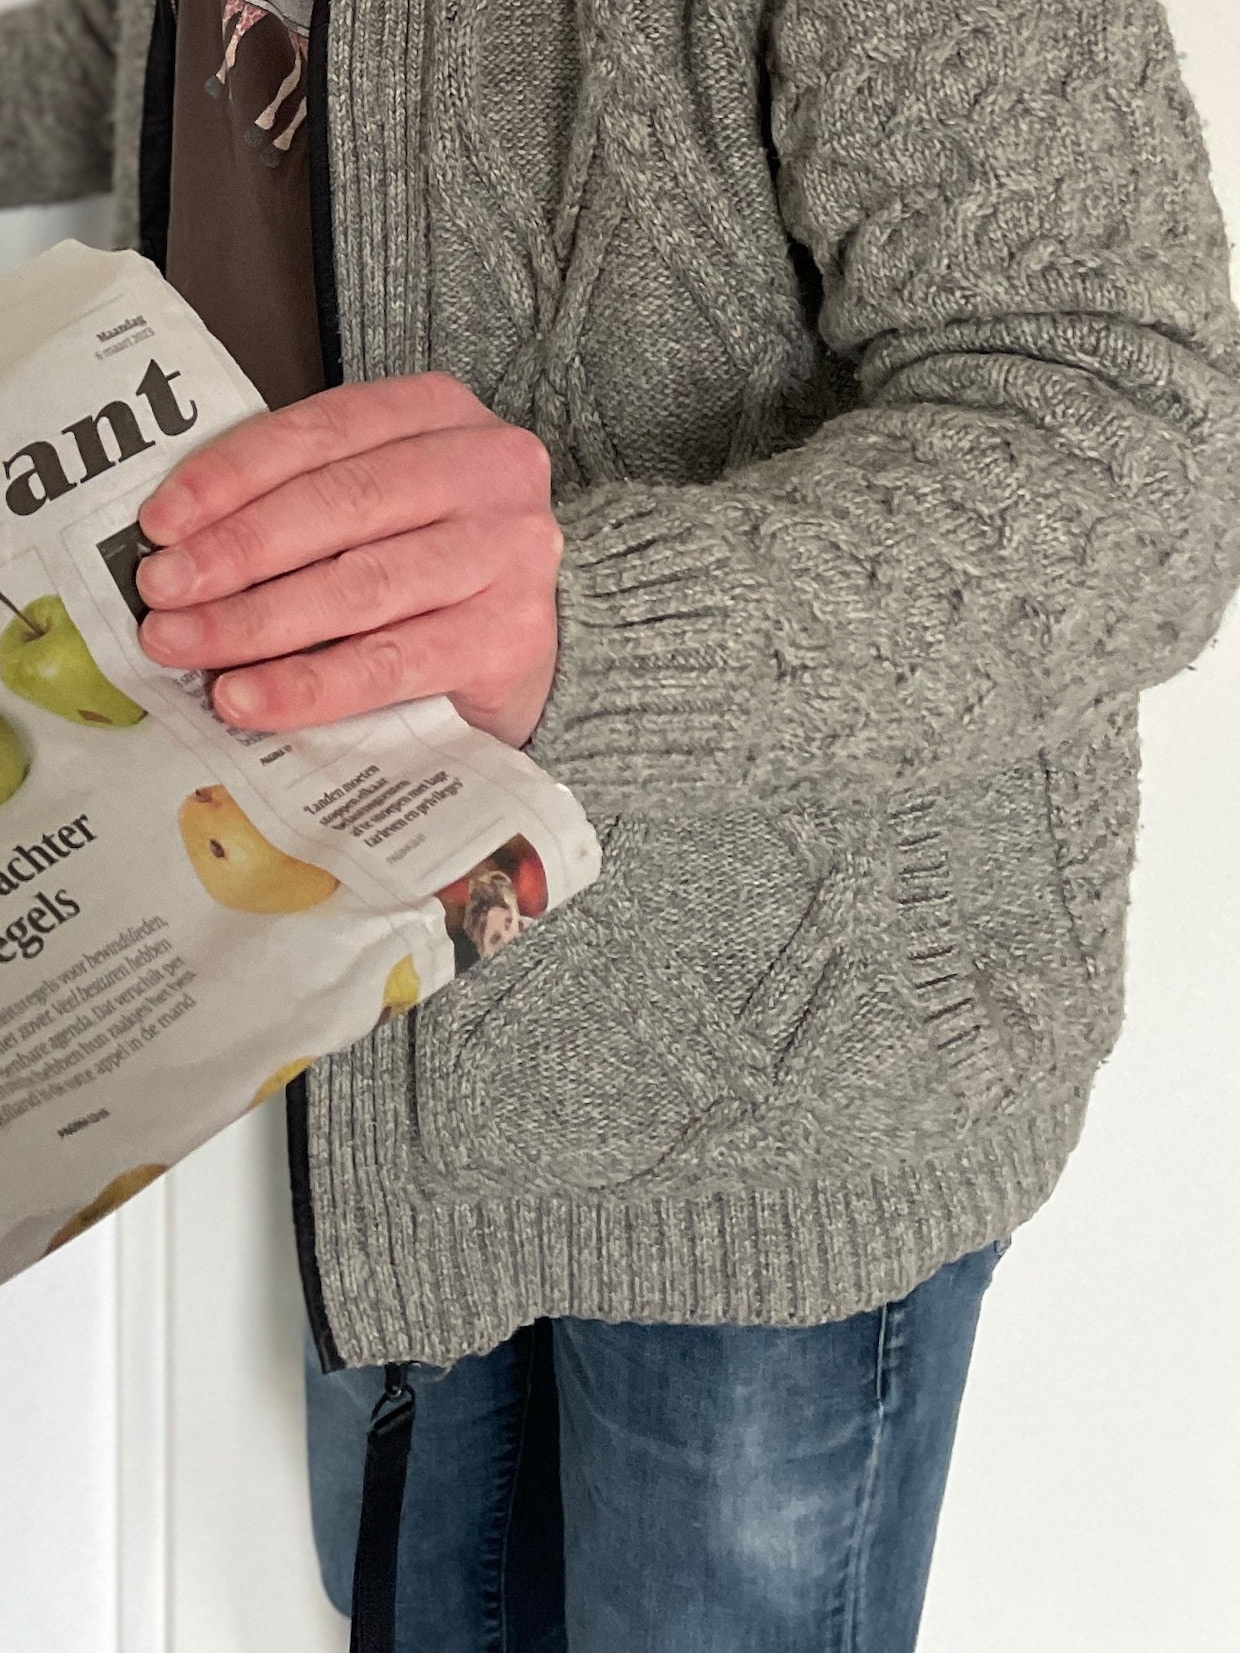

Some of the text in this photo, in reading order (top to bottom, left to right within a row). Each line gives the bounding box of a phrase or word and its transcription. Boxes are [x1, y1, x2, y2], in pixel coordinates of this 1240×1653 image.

[95, 314, 147, 343] Maandag
[341, 764, 380, 792] moeten
[403, 808, 420, 822] en
[50, 989, 81, 1016] Veel
[123, 938, 173, 972] hebben
[56, 960, 87, 984] voor
[90, 999, 117, 1022] Dat
[161, 955, 186, 977] per
[124, 1036, 145, 1052] in
[139, 1023, 160, 1042] de
[156, 992, 196, 1028] mand
